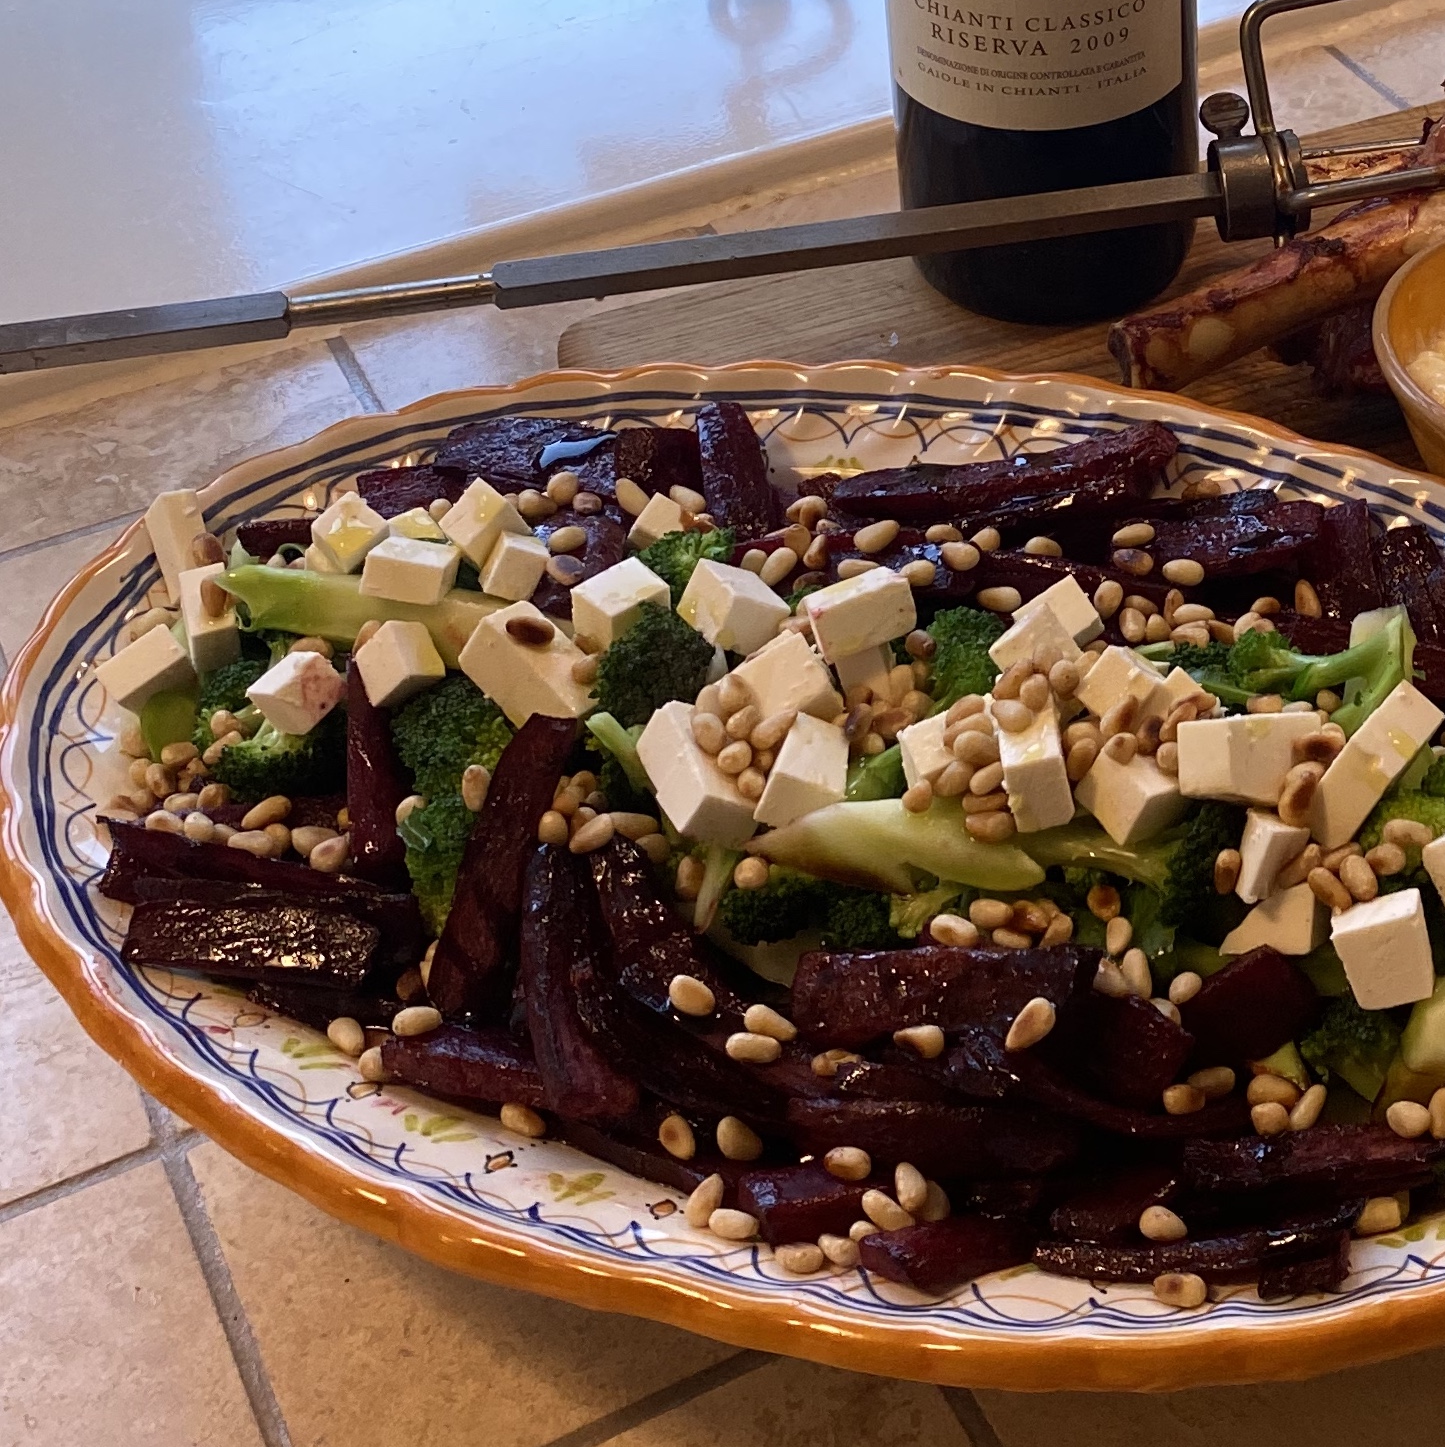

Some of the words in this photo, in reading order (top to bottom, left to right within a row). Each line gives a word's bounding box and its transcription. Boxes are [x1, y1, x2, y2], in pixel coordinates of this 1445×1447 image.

[930, 21, 1048, 56] RISERVA
[1070, 27, 1129, 54] 2009
[917, 61, 971, 90] GAIOLE
[976, 82, 994, 94] IN
[1001, 85, 1080, 97] CHIANTI
[1097, 66, 1148, 90] ITALIA
[991, 68, 1028, 80] ORIGINE
[1030, 67, 1096, 81] CONTROLLATA
